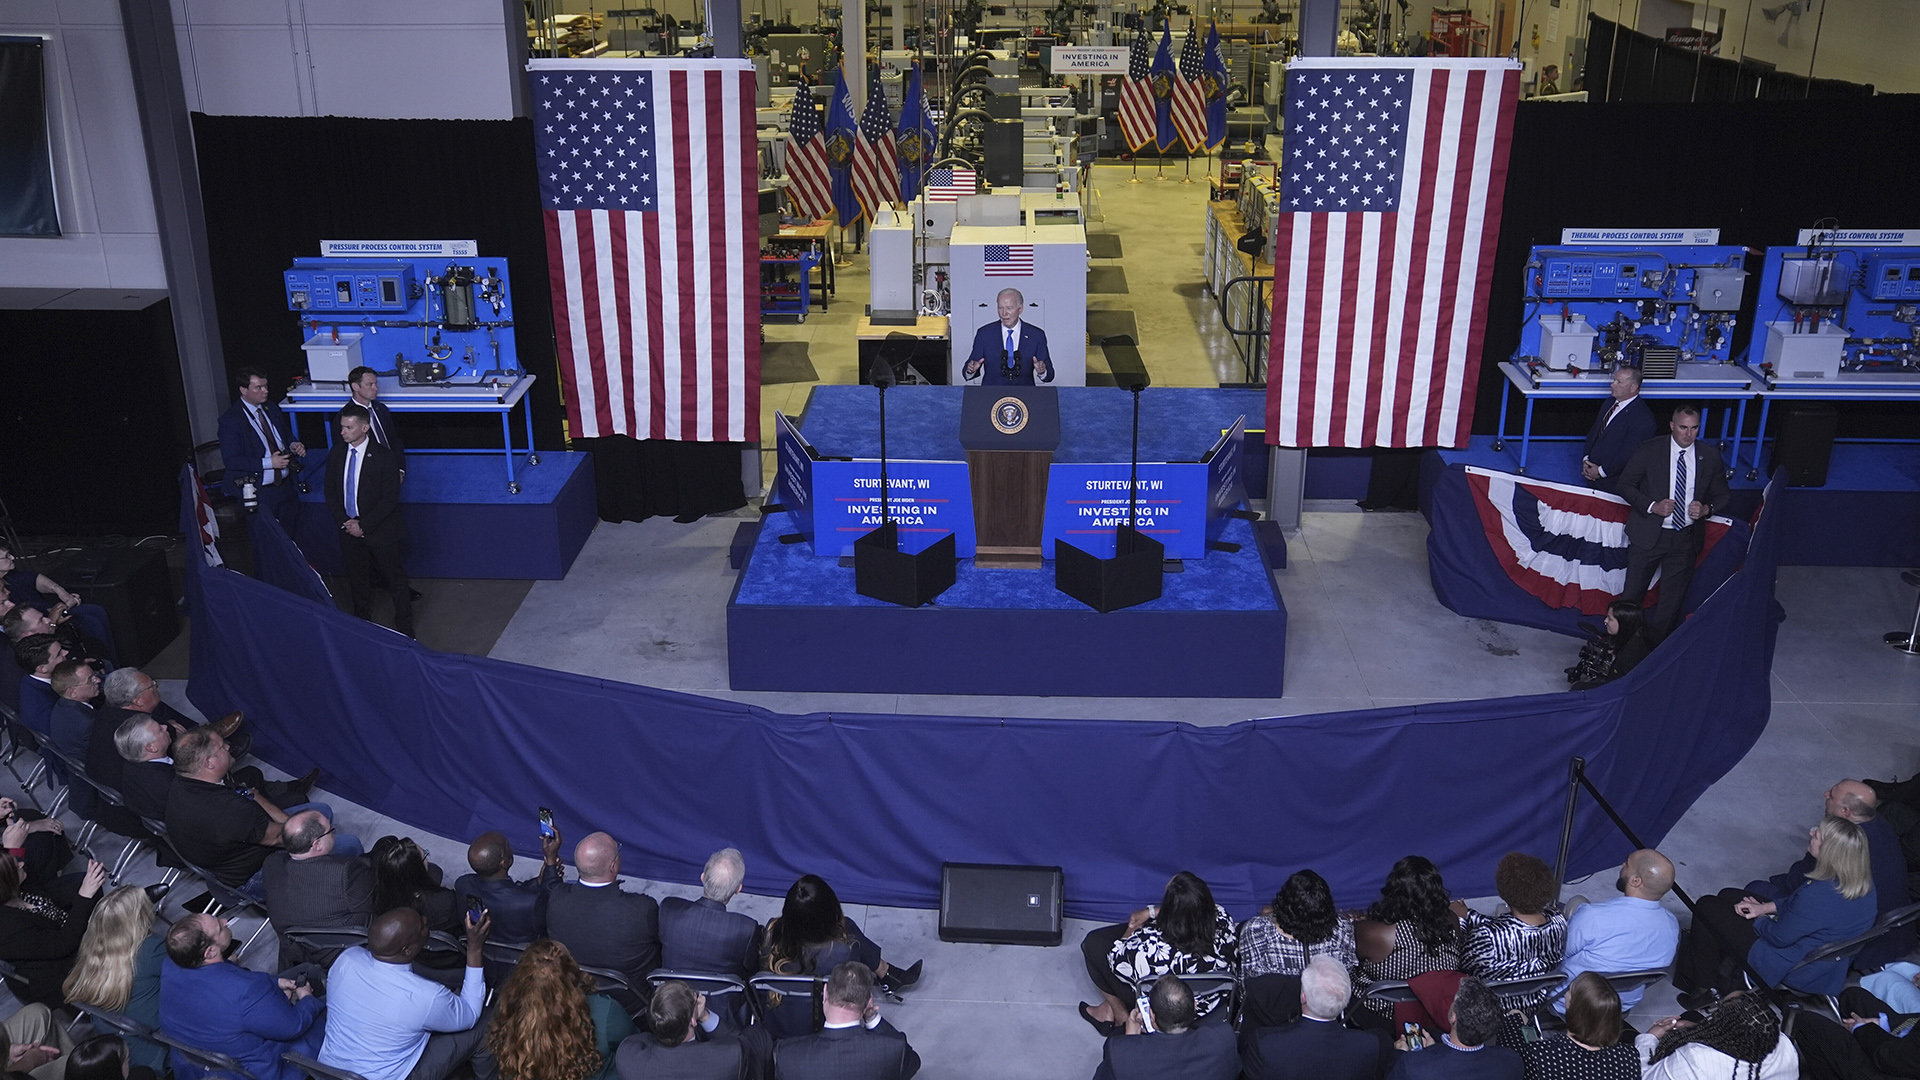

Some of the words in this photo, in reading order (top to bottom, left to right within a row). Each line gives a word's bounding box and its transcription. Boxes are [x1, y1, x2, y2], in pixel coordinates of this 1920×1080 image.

[1848, 232, 1878, 240] CONTROL
[1878, 232, 1905, 240] SYSTEM
[917, 479, 930, 489] WI
[1150, 480, 1163, 490] WI
[923, 506, 937, 515] IN
[1155, 507, 1169, 516] IN
